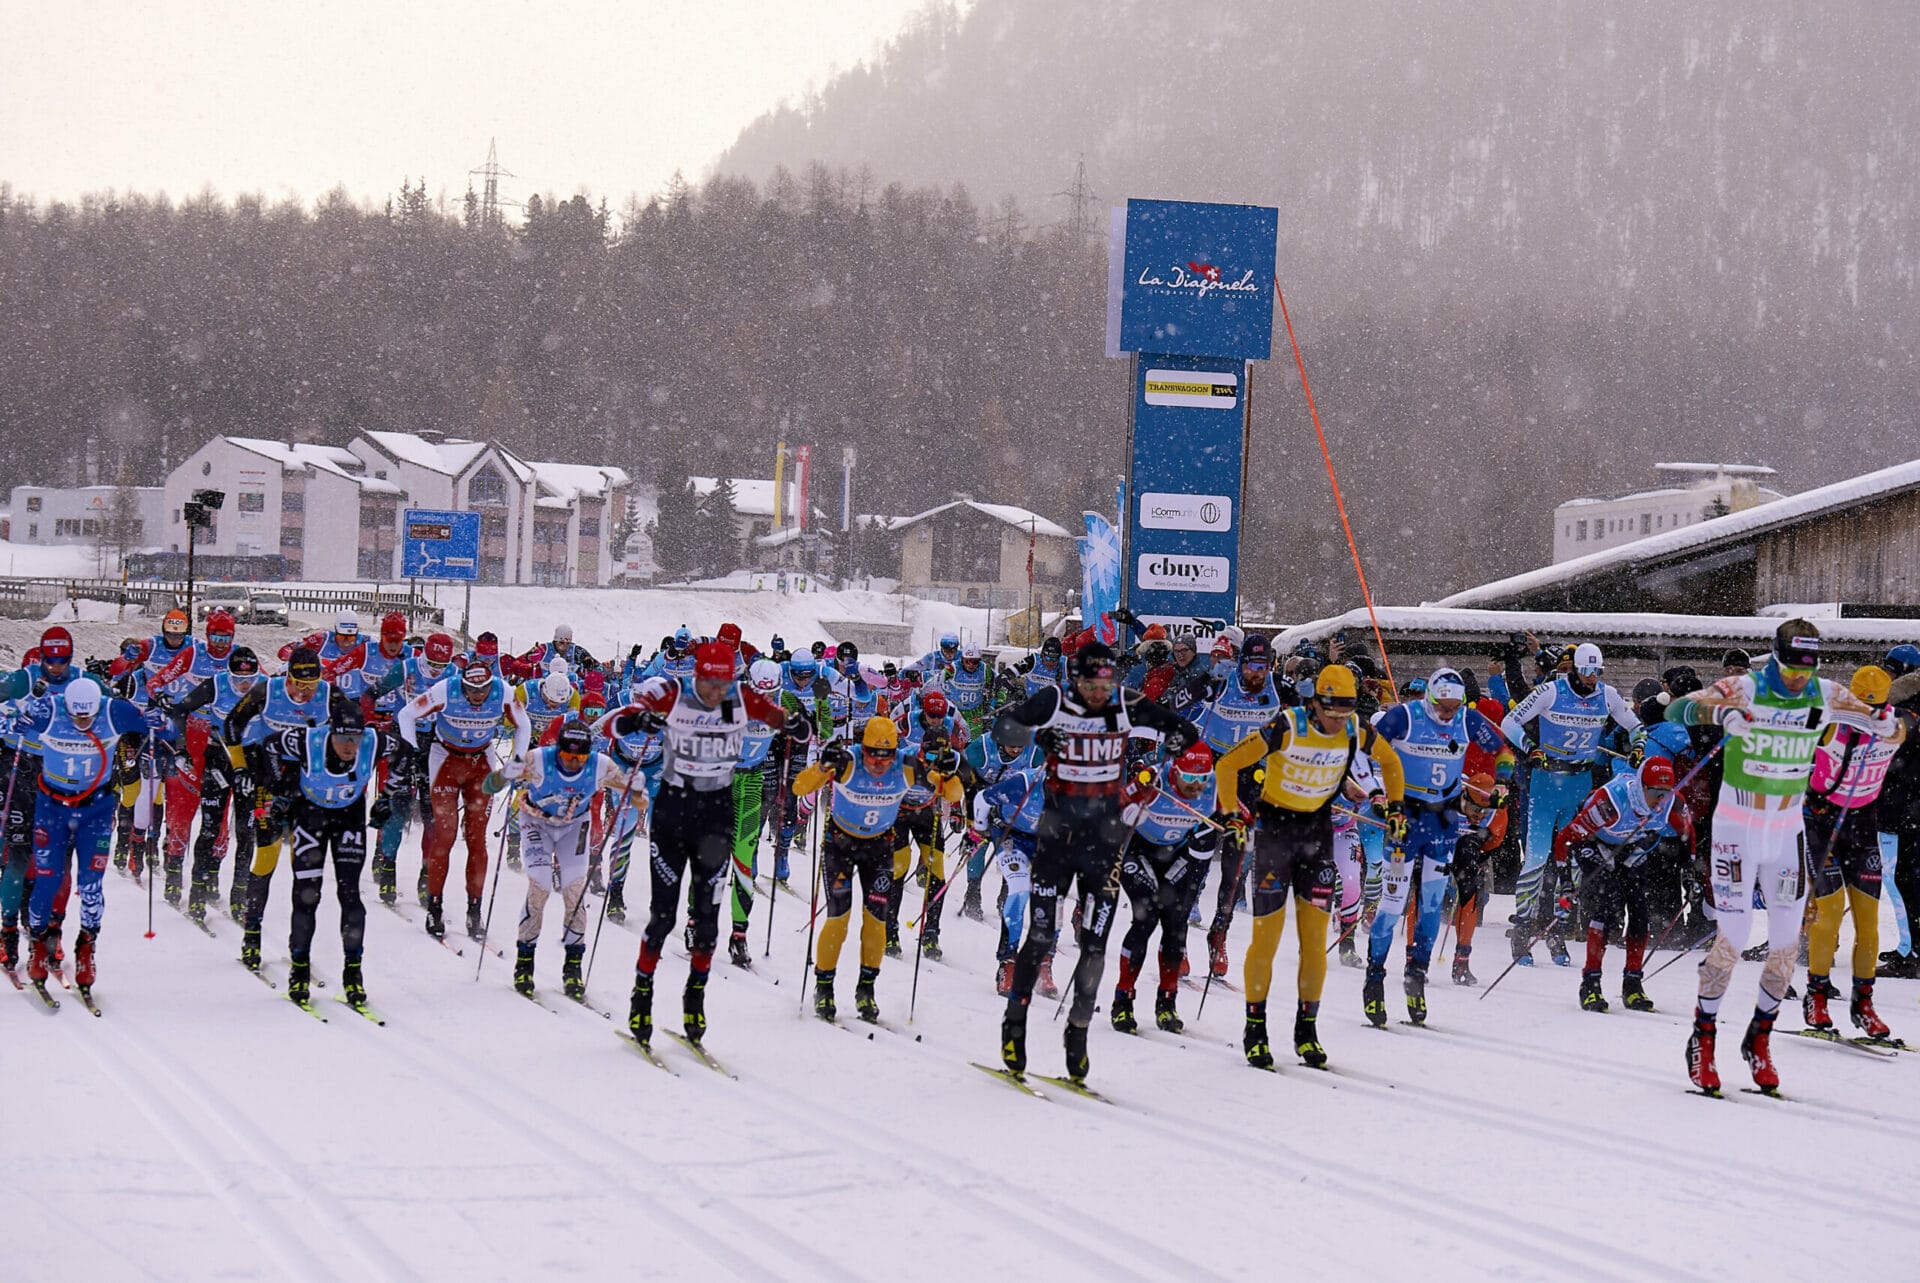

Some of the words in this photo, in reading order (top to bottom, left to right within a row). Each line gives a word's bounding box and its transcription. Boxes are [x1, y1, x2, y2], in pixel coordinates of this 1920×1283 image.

[1138, 267, 1164, 285] La
[1167, 266, 1259, 297] Diagonela
[1148, 383, 1209, 393] TRANSWAGGON
[1149, 557, 1219, 582] cbuy.ch
[961, 692, 977, 703] 60
[72, 702, 93, 710] RWT
[1219, 707, 1267, 716] CERTINA
[1551, 714, 1599, 722] CERTINA
[1563, 731, 1593, 749] 22
[1409, 745, 1457, 754] CERTIN
[64, 757, 92, 776] 11
[1431, 763, 1447, 786] 5
[201, 798, 220, 807] Fuel
[864, 810, 880, 826] 8
[1033, 882, 1057, 897] Fuel
[1094, 902, 1113, 938] swix
